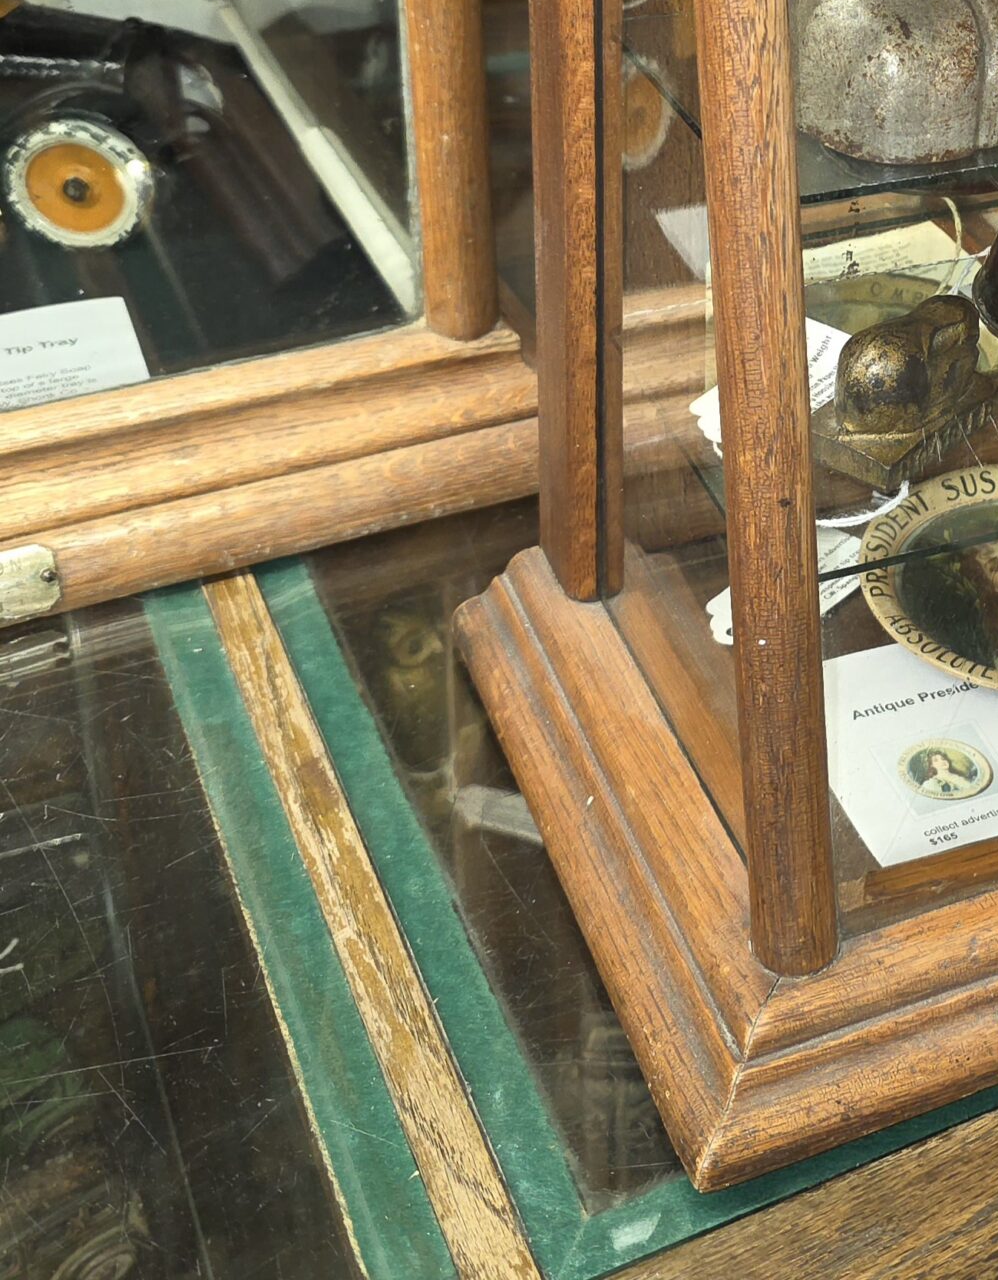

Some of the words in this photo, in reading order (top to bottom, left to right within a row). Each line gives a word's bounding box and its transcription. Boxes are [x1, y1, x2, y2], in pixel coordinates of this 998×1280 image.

[5, 347, 33, 355] Tip
[38, 337, 78, 349] Tray
[810, 335, 832, 363] Weight
[866, 490, 929, 599] PRESIDENT
[884, 614, 995, 681] ABSOLUTE
[852, 697, 915, 720] Antique
[918, 678, 978, 702] Preside
[924, 821, 959, 837] collect
[929, 832, 959, 846] $165
